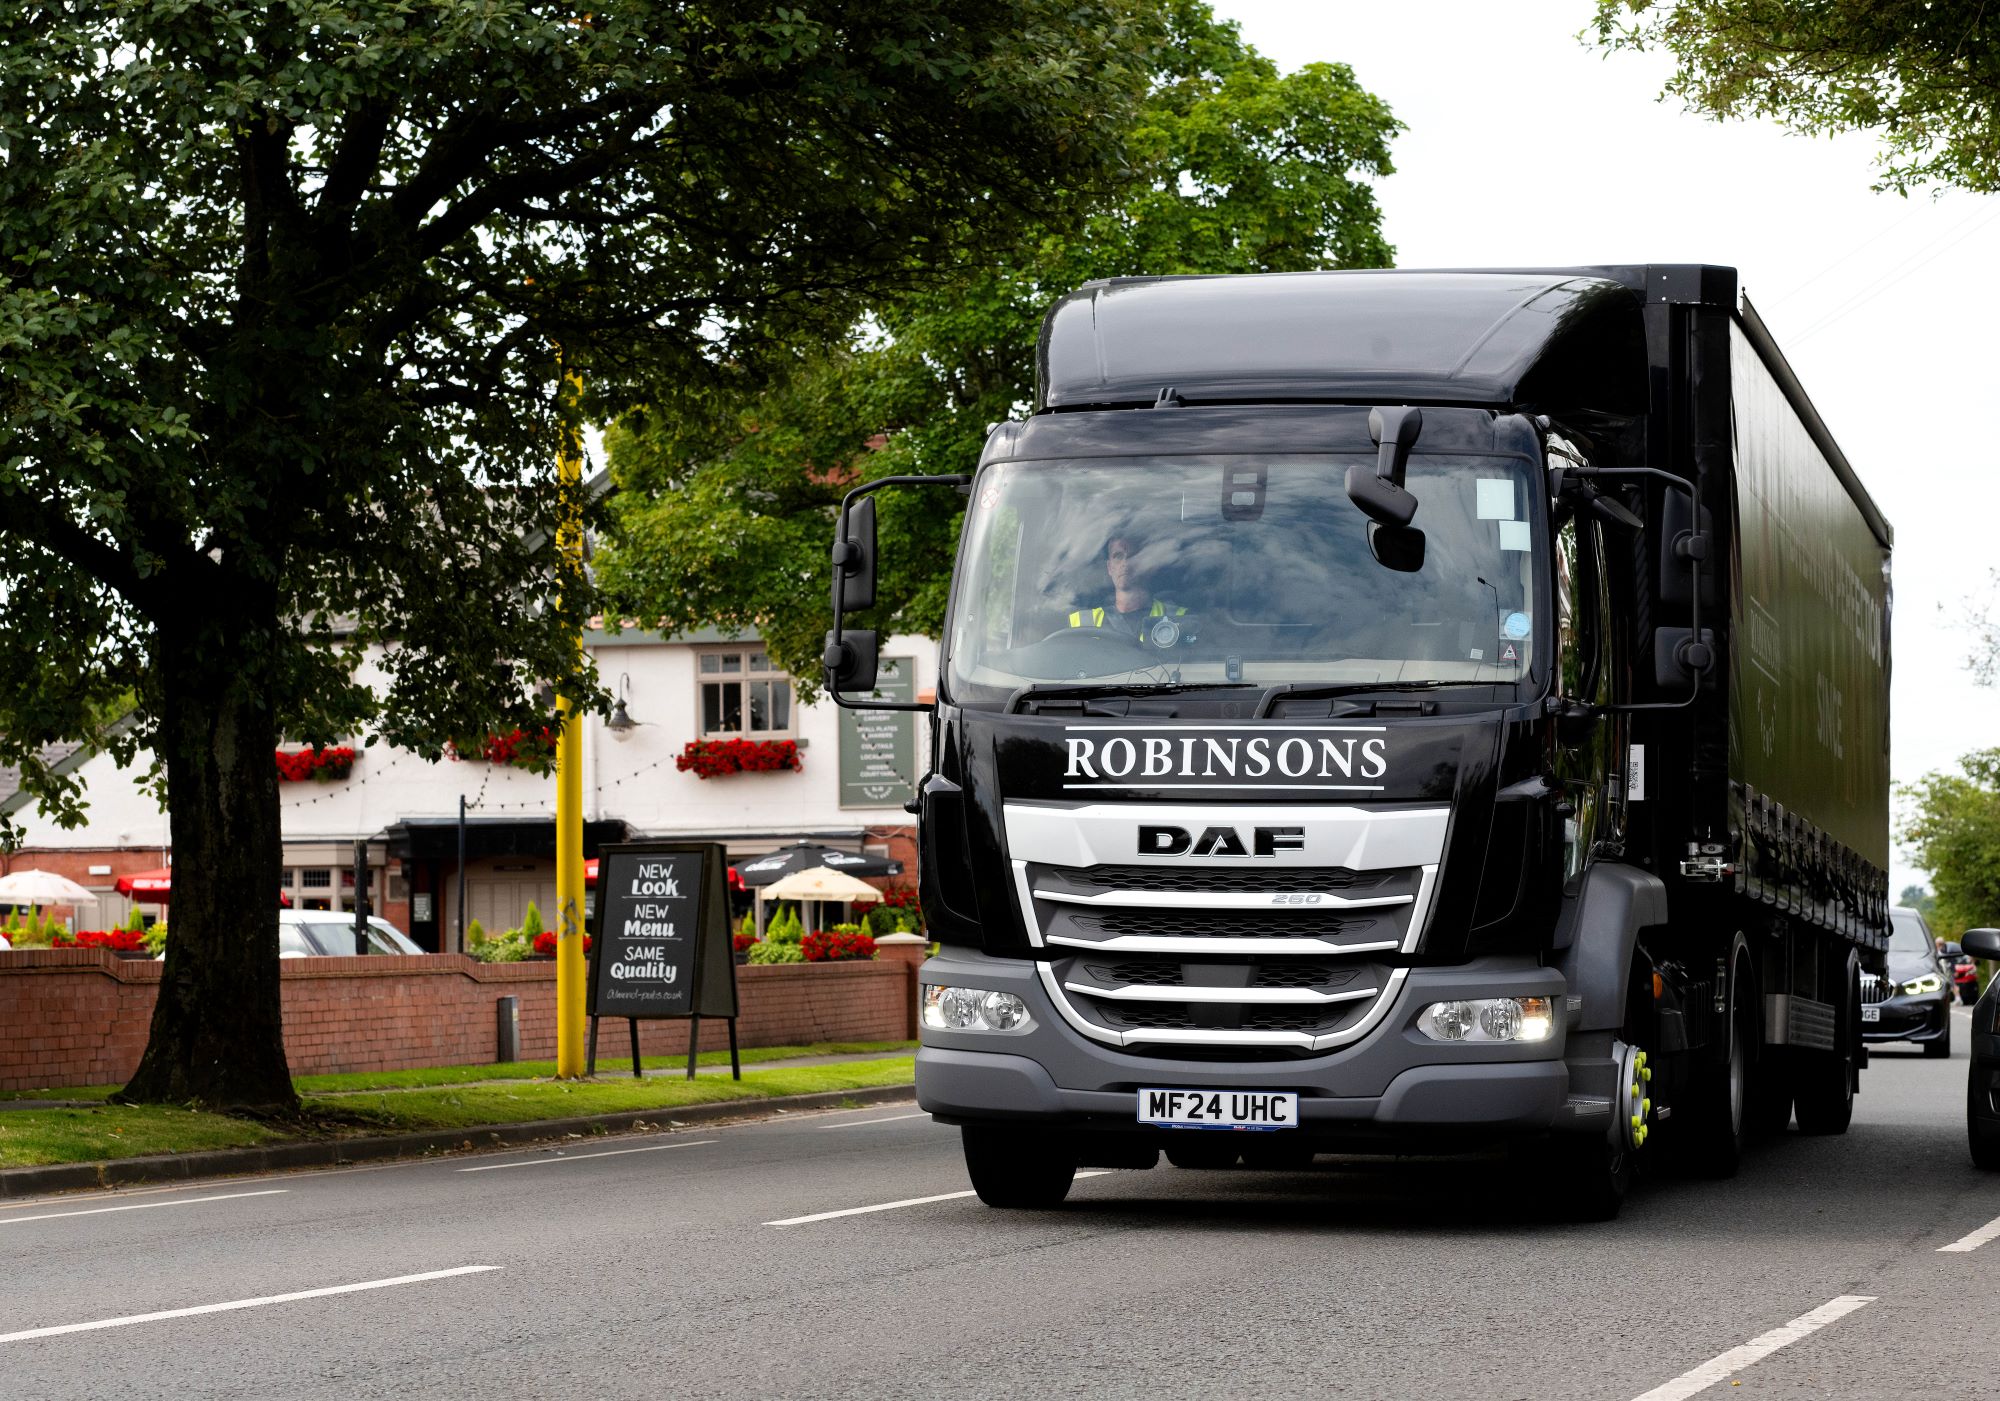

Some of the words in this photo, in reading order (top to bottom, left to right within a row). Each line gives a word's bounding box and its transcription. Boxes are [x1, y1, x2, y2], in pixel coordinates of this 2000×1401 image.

[1817, 671, 1843, 760] SINCE
[861, 743, 893, 751] COCTAILS
[1063, 737, 1387, 779] ROBINSONS
[1137, 824, 1305, 858] DAF
[638, 863, 674, 879] NEW
[1271, 893, 1322, 905] 260
[634, 904, 669, 919] NEW
[623, 919, 675, 937] Menu
[624, 946, 665, 961] SAME
[610, 961, 677, 984] Quality
[1149, 1091, 1223, 1120] MF24
[1231, 1094, 1287, 1122] UHC
